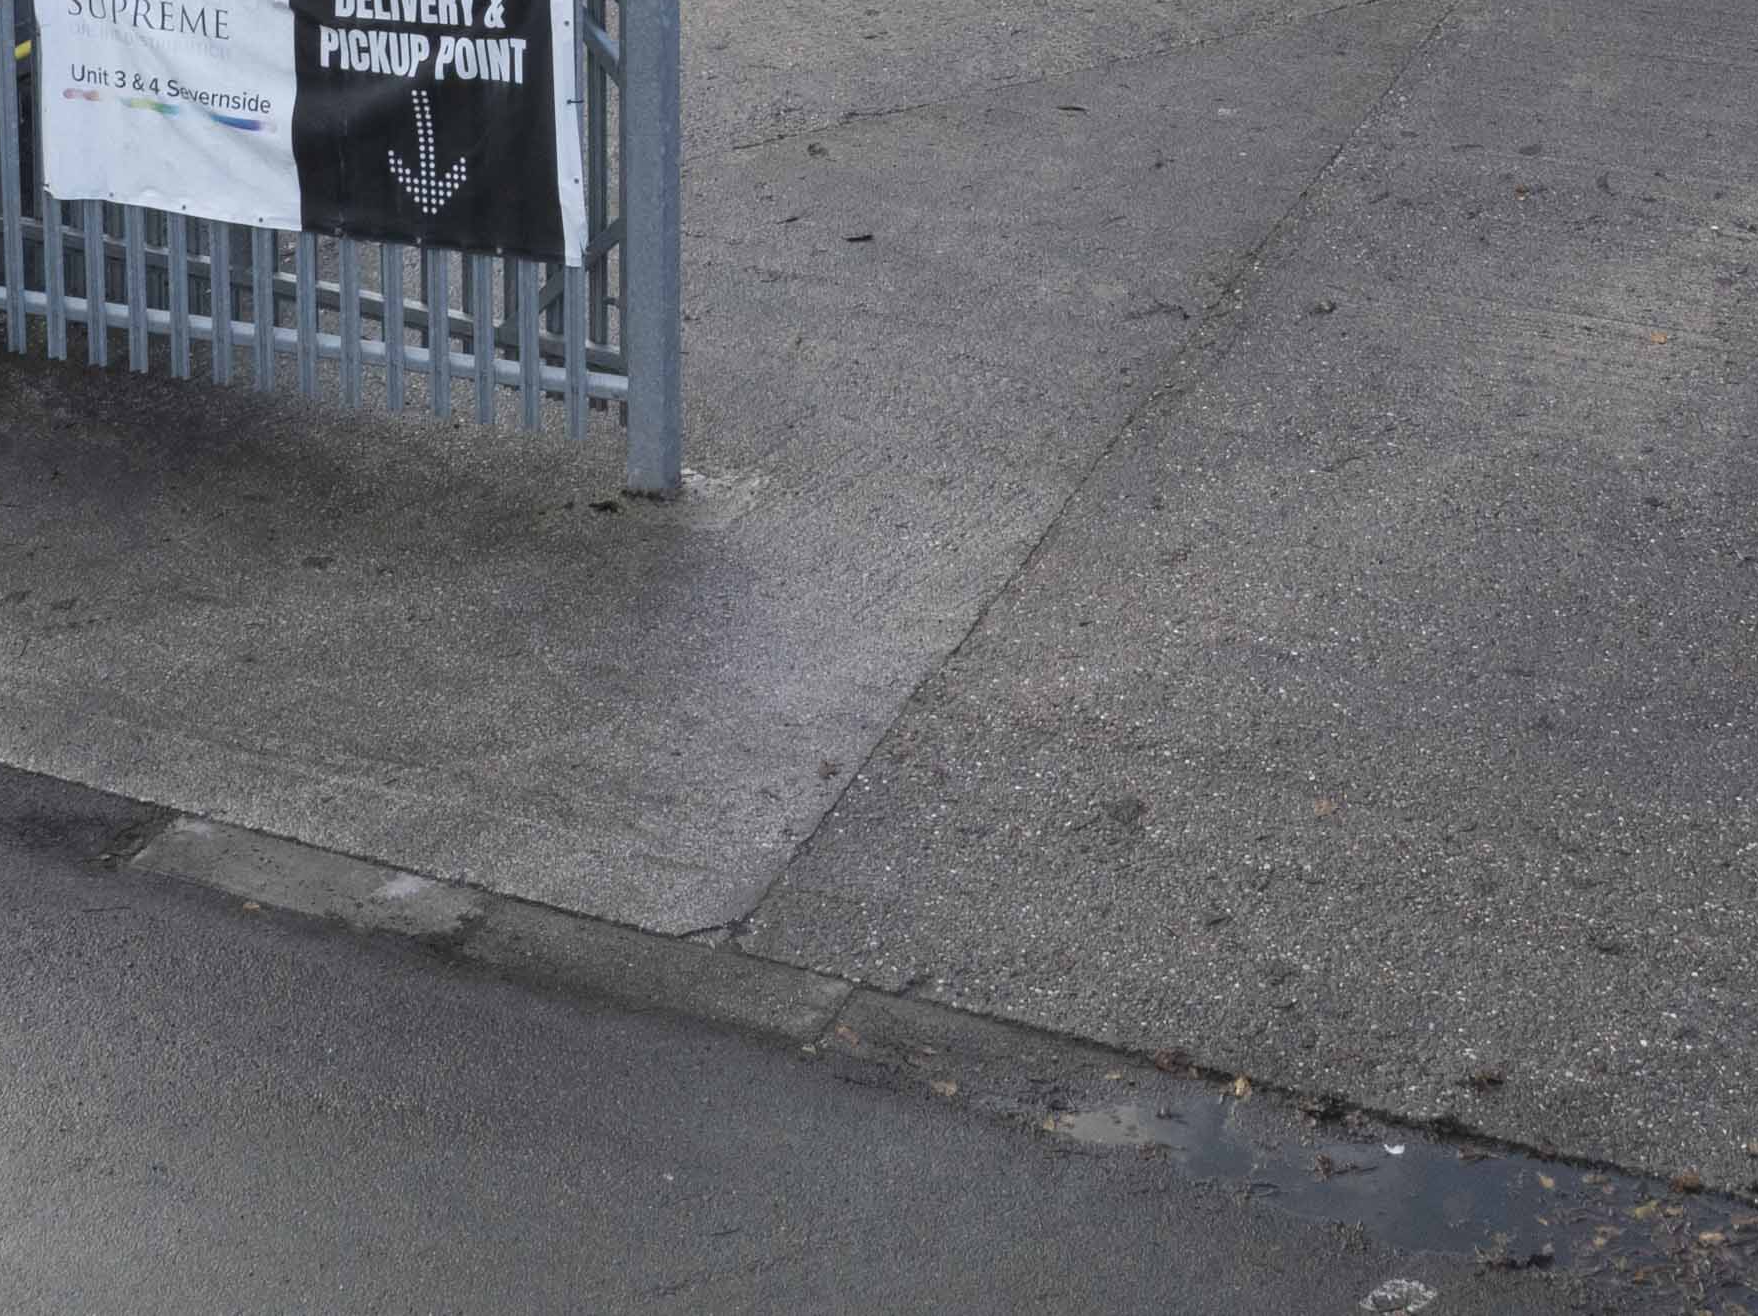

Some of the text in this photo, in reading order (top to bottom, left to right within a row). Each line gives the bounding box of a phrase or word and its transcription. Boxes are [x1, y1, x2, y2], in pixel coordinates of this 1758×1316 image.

[319, 24, 527, 85] PICKUP POINT
[71, 63, 271, 114] Unit 3 & 4 Severnside
